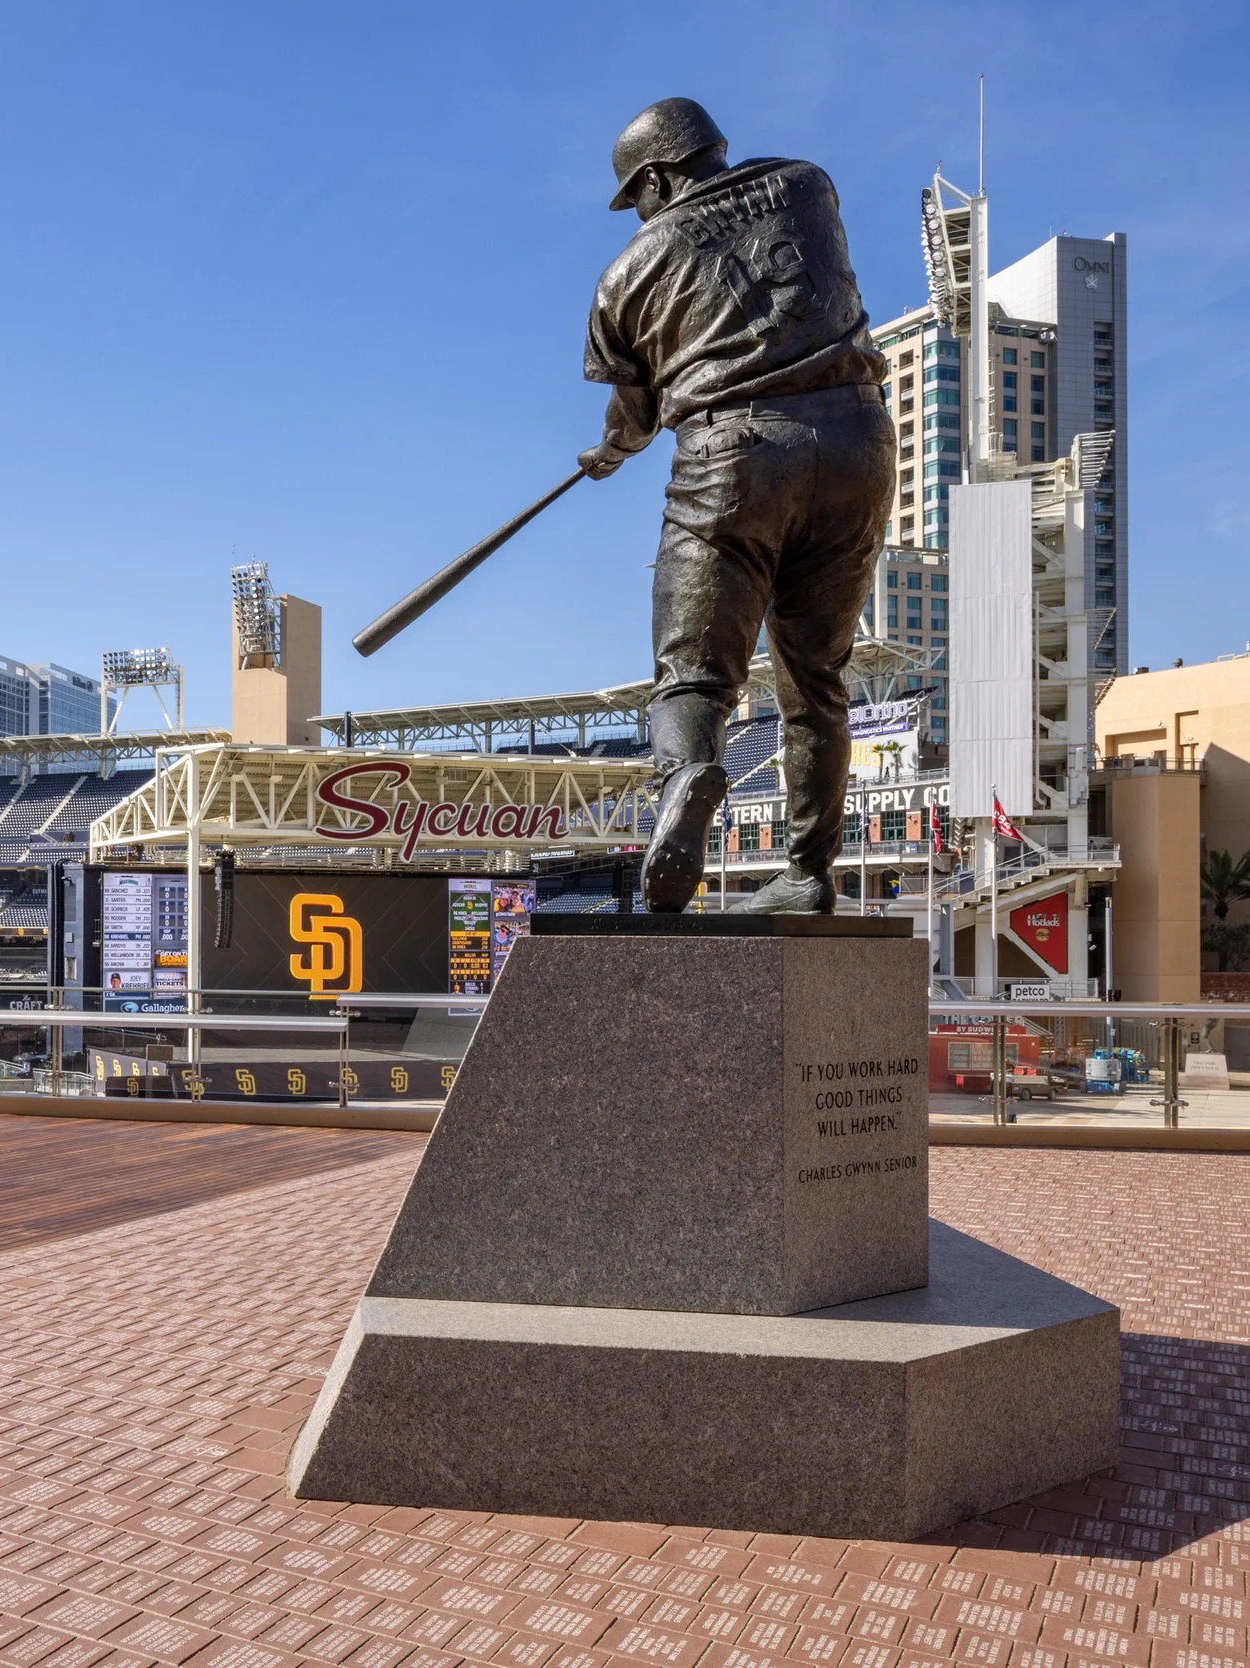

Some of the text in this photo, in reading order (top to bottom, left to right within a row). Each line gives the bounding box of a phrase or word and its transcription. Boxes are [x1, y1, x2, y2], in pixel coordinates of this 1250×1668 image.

[714, 230, 830, 337] 19
[315, 761, 571, 863] Sycuan
[844, 787, 915, 815] SUPPLY
[1015, 986, 1046, 998] petco
[9, 1000, 43, 1010] CRAFT
[142, 1004, 184, 1013] Gallagher
[817, 1062, 844, 1081] YOU
[848, 1060, 884, 1078] WORK
[888, 1058, 919, 1076] HARD
[815, 1086, 903, 1110] GOOD THINGS
[817, 1119, 847, 1137] WILL
[798, 1155, 918, 1184] CHARLES GWYNN SENIOR
